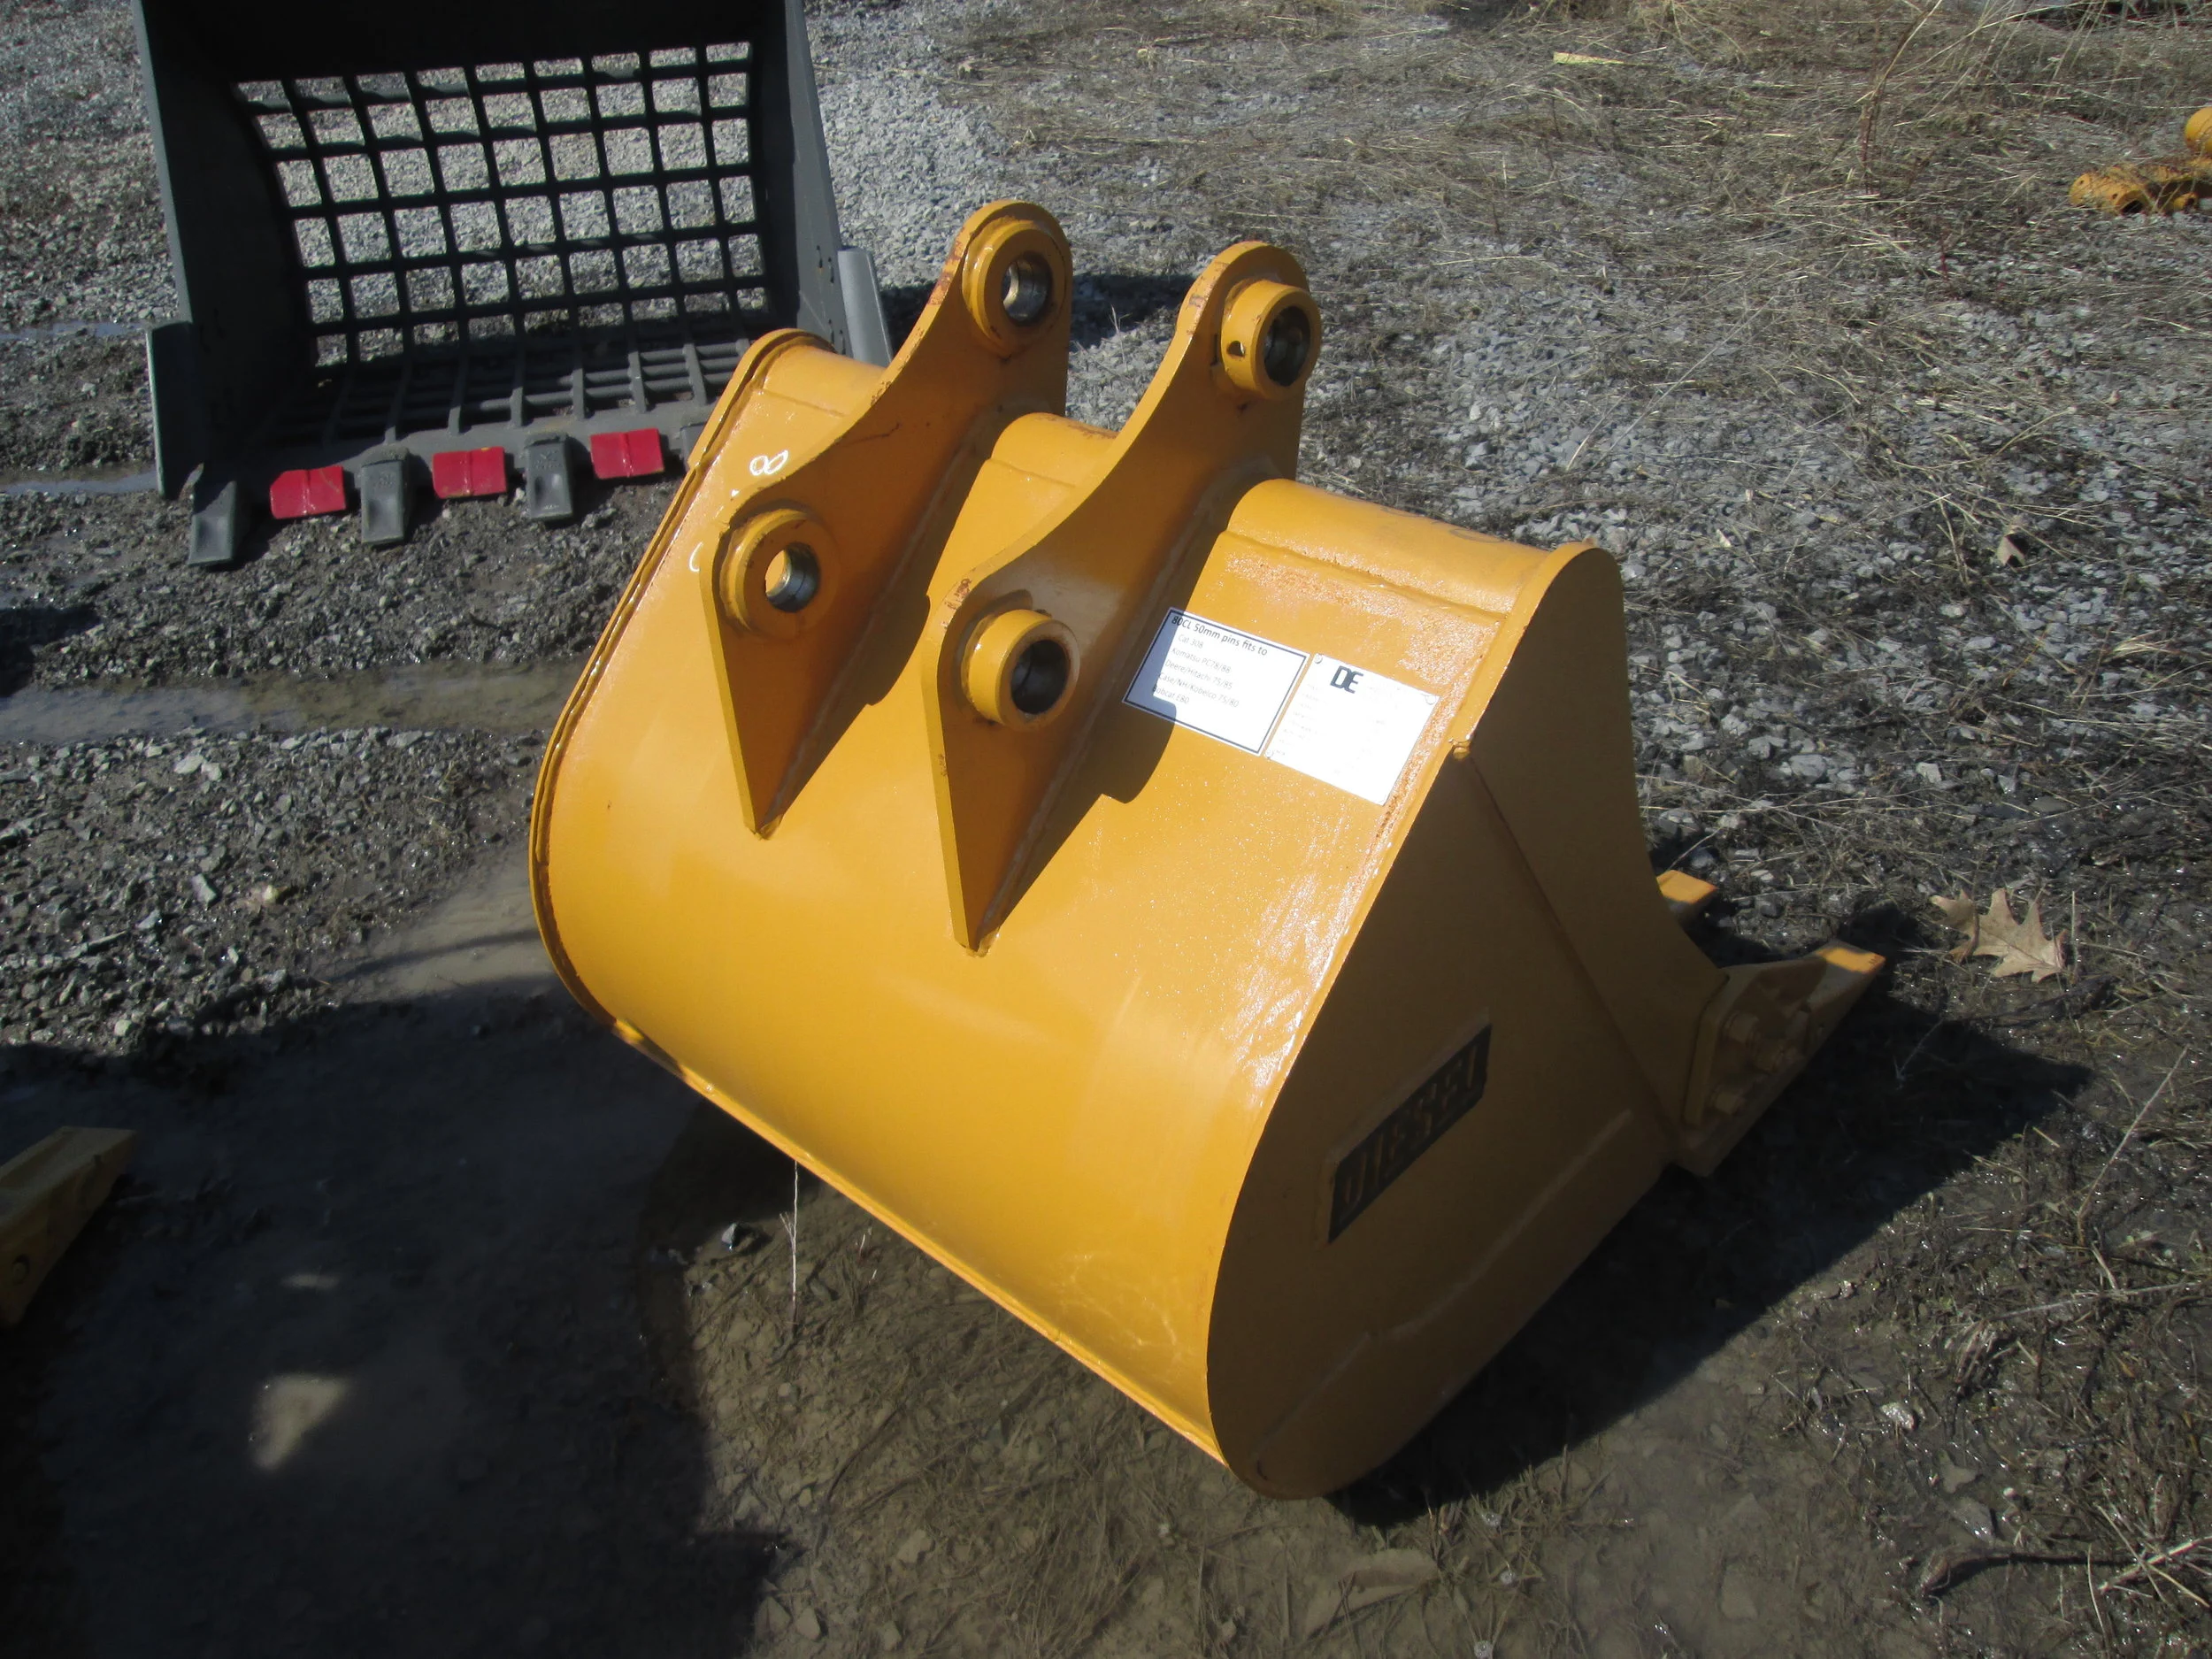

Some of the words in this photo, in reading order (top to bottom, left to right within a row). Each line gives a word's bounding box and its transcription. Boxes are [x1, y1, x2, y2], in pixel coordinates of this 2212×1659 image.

[1171, 615, 1191, 630] 80CL
[1194, 623, 1220, 640] 50mm
[1221, 634, 1240, 647] pins
[1241, 640, 1256, 652] fits
[1257, 646, 1268, 656] to
[1178, 634, 1190, 643] Cat
[1190, 638, 1204, 649] 308
[1171, 647, 1200, 663] Komatsu
[1158, 672, 1217, 699] Case/NH/Kobelco
[1164, 659, 1211, 681] Deere/Hitachi
[1212, 676, 1233, 690] 75/85
